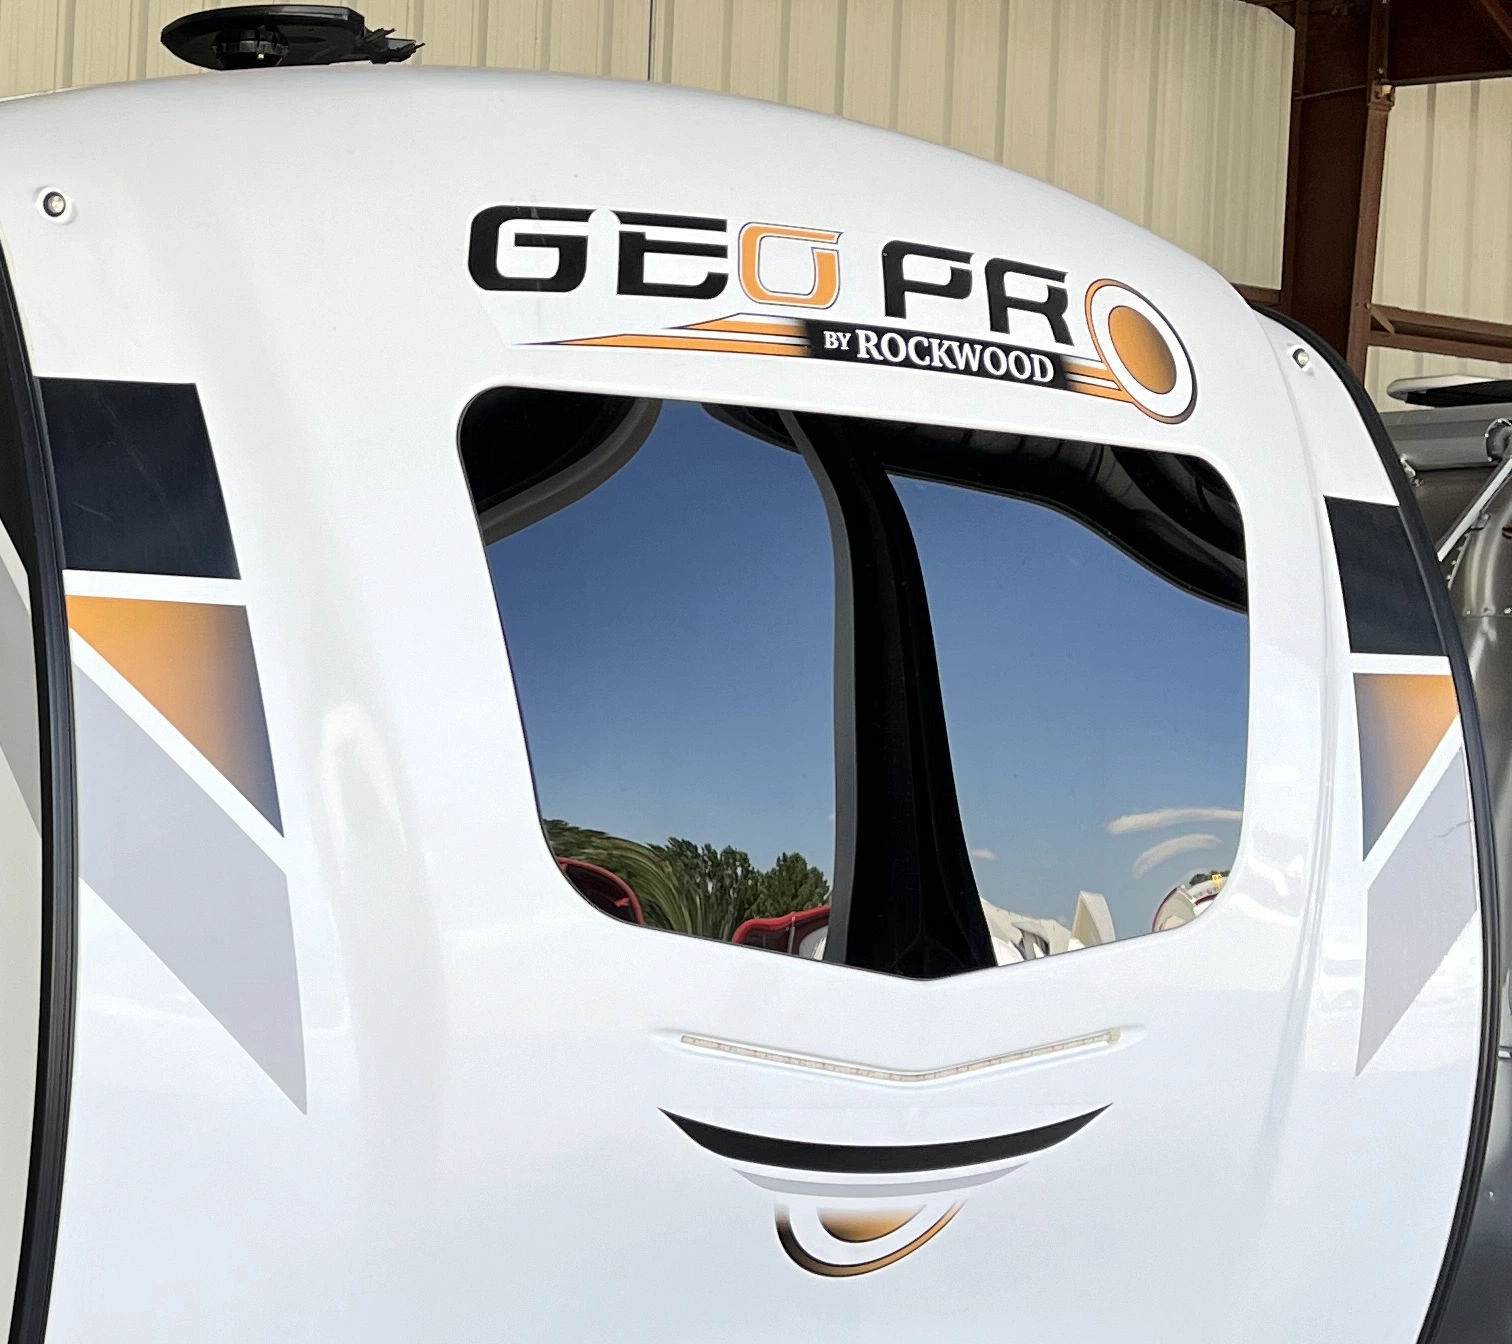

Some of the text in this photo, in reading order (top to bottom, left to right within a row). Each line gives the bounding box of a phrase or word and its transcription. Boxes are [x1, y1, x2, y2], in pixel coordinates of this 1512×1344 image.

[467, 204, 845, 311] GEO
[823, 328, 1056, 385] BY ROCKWOOD
